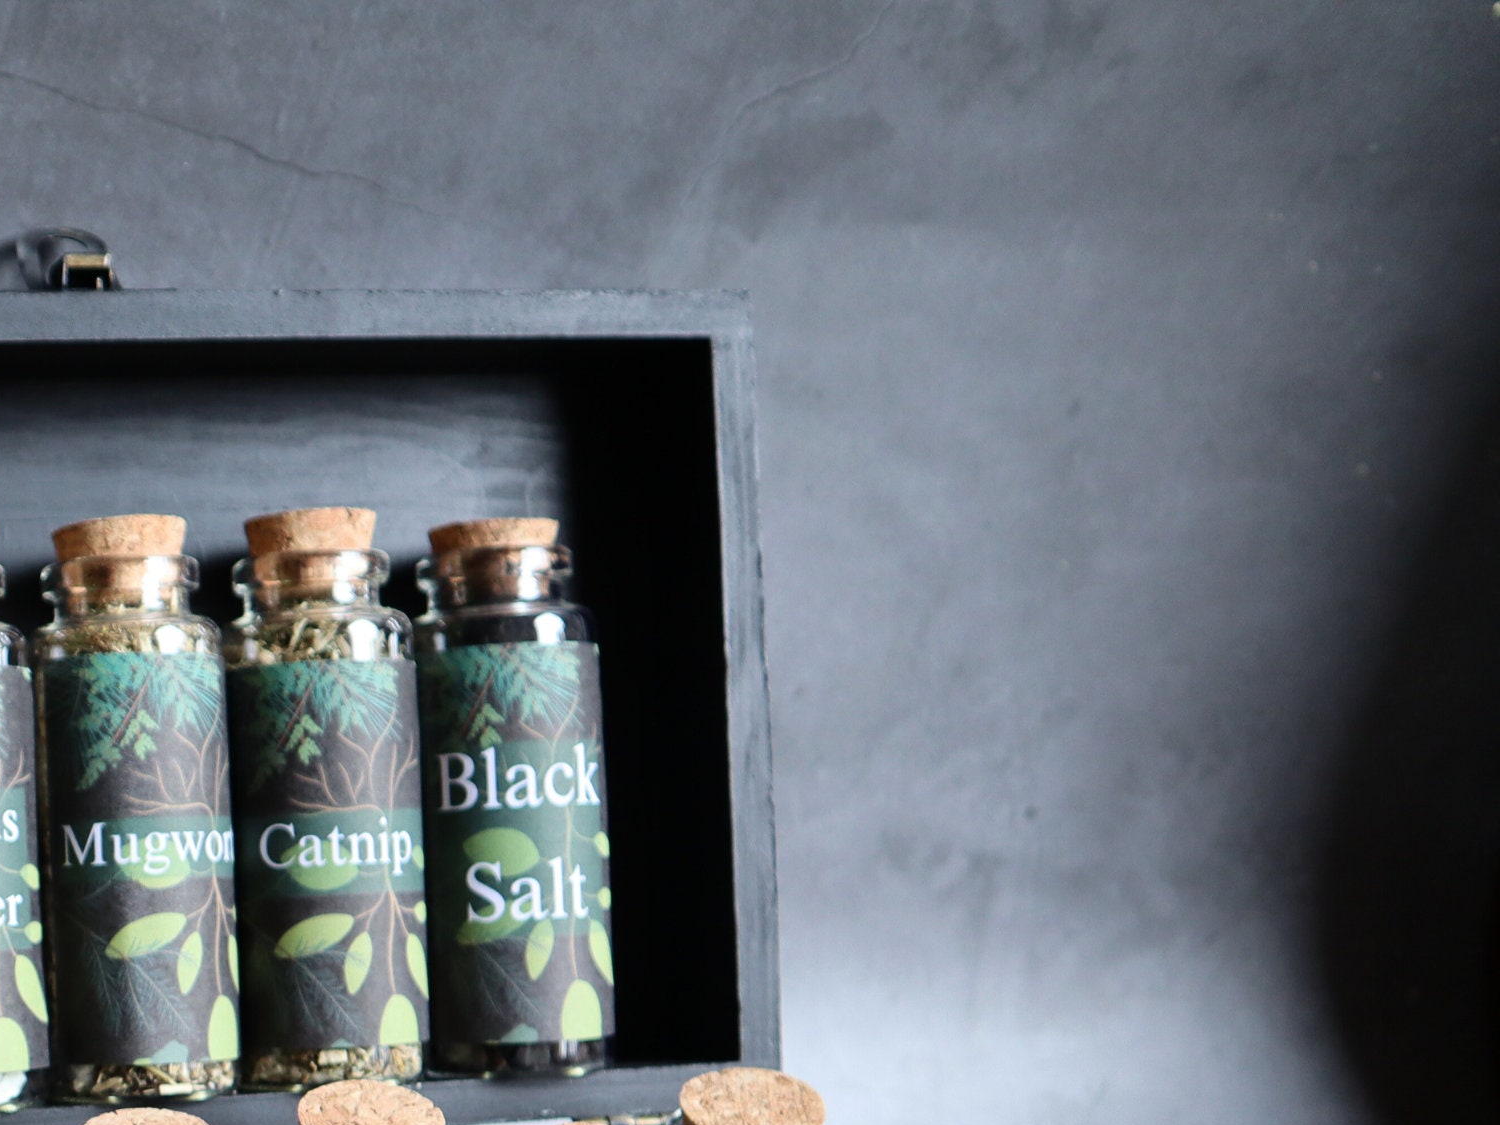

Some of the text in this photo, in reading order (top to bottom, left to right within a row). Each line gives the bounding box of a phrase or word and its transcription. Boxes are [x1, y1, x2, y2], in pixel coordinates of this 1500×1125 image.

[437, 742, 601, 812] Black
[259, 817, 412, 877] Catnip
[466, 856, 589, 923] Salt
